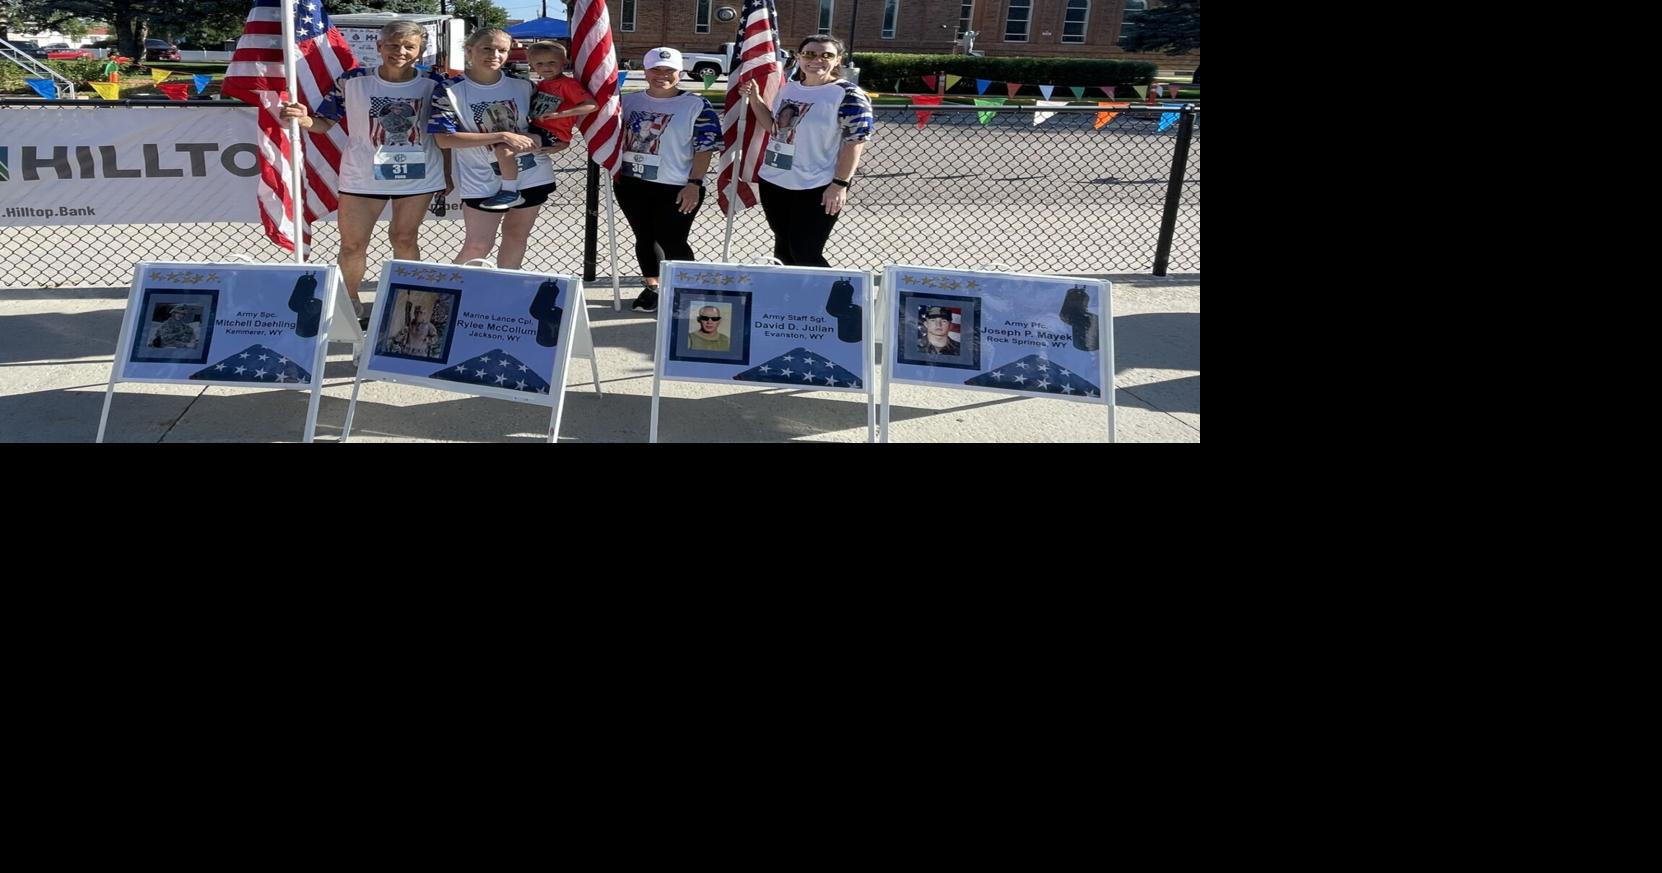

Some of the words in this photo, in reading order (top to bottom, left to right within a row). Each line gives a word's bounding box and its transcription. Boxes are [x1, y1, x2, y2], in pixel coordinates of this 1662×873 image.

[392, 164, 408, 174] 31
[632, 163, 644, 174] 30
[236, 311, 258, 319] Army
[463, 311, 490, 320] Marine
[491, 314, 517, 323] Lance
[762, 313, 785, 322] Army
[216, 319, 252, 327] Mitchell
[254, 320, 296, 330] Daehling
[456, 319, 484, 329] Rylee
[487, 322, 537, 336] McCollum
[754, 321, 785, 330] David
[788, 323, 799, 331] D.
[801, 324, 834, 333] Julian
[1004, 320, 1028, 329] Army
[468, 330, 505, 341] Jackson,
[507, 334, 520, 342] WY
[764, 330, 807, 340] Evanston,
[981, 327, 1021, 337] Joseph
[1024, 330, 1034, 338] P.
[1037, 331, 1072, 341] Mayek
[986, 335, 1009, 343] Rock
[1011, 338, 1049, 347] Springs,
